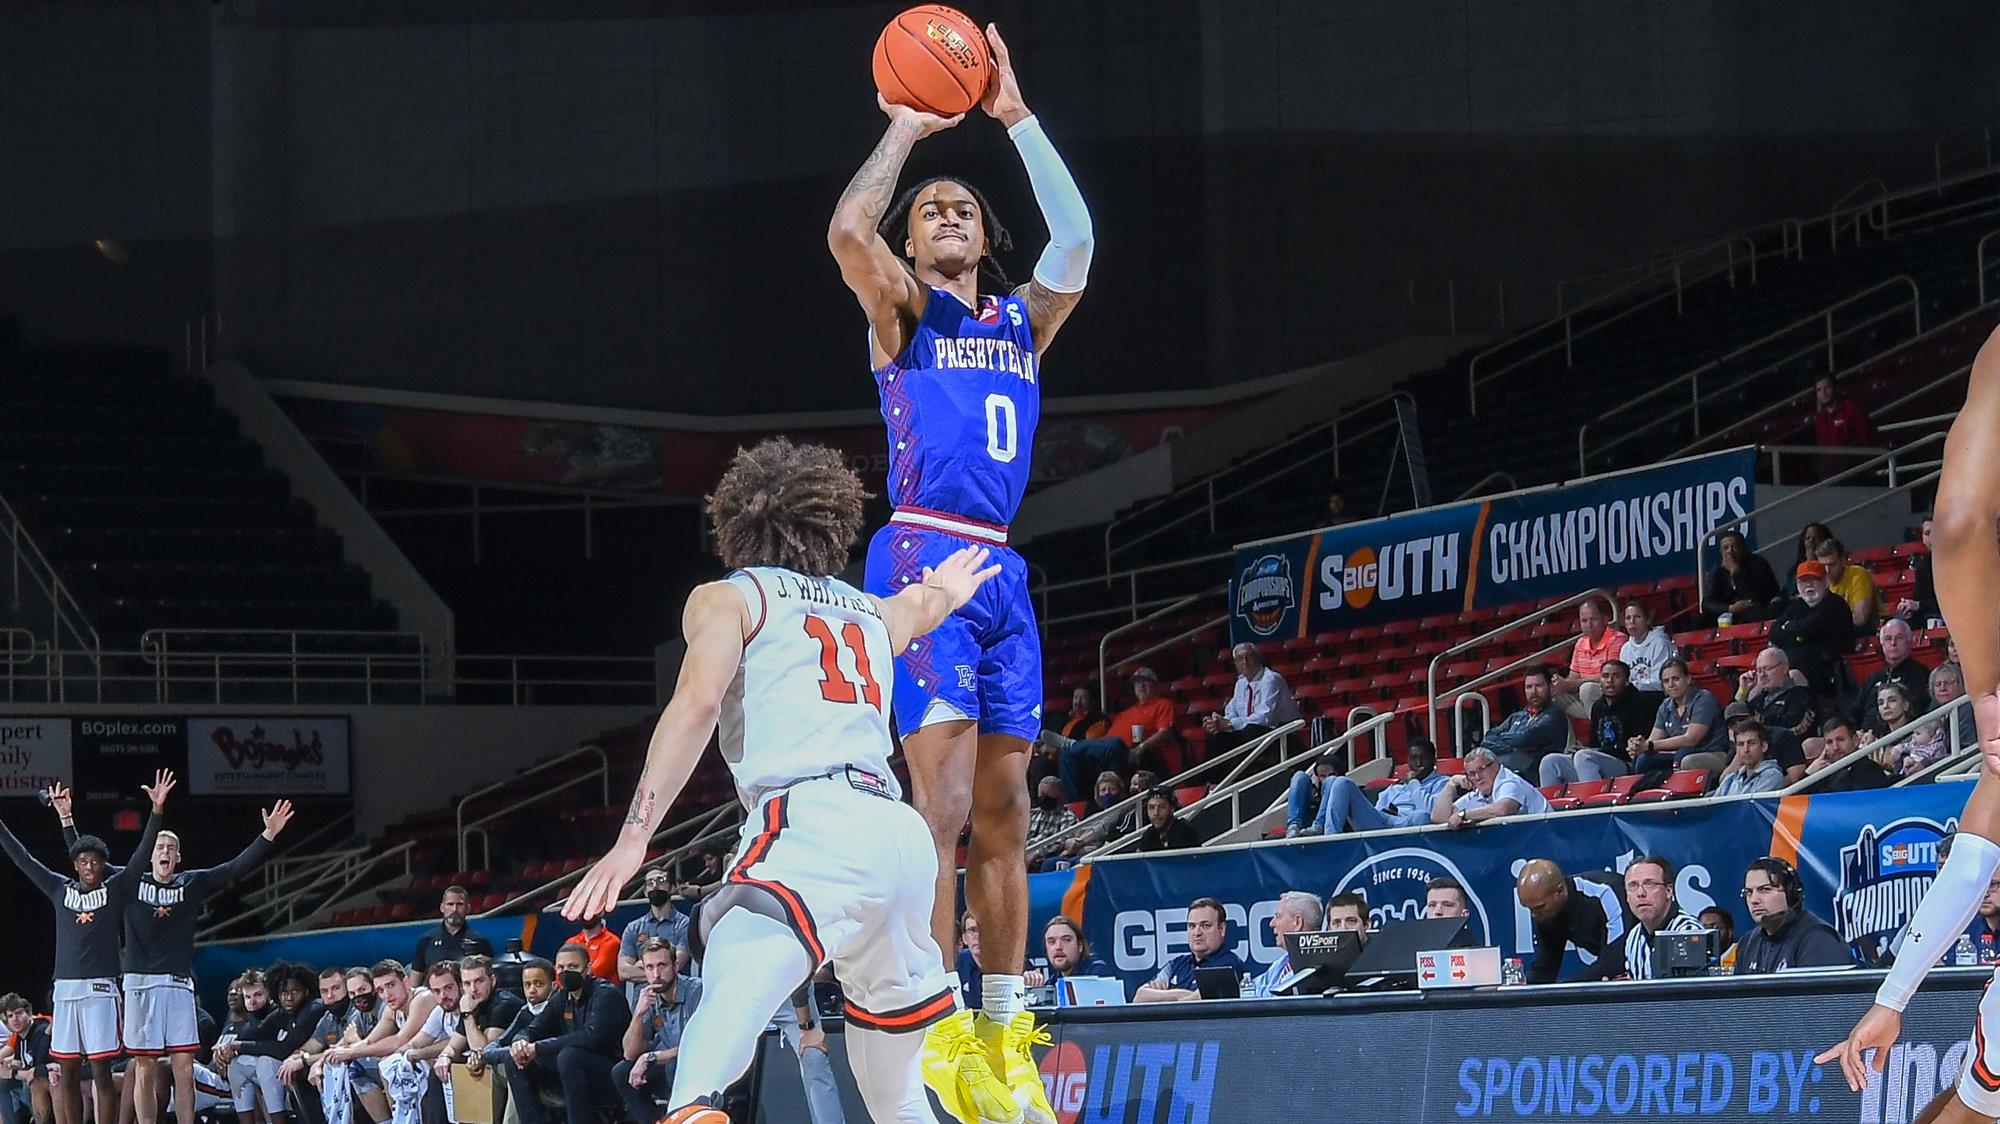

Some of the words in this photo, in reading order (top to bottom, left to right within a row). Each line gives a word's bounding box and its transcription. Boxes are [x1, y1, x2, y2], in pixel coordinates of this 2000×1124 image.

[984, 393, 1018, 464] 0
[1489, 476, 1749, 584] CHAMPIONSHIPS
[777, 576, 791, 598] J.
[803, 613, 882, 716] 11
[0, 724, 43, 744] pert
[81, 721, 176, 737] BOplex.com
[1372, 868, 1402, 886] SINCE
[1407, 868, 1431, 884] 1956
[64, 887, 81, 909] NO
[81, 887, 108, 911] QUIT
[138, 881, 156, 903] NO
[158, 887, 184, 905] QUIT
[1454, 1052, 1734, 1117] SPONSORED
[1748, 1050, 1824, 1115] BY:
